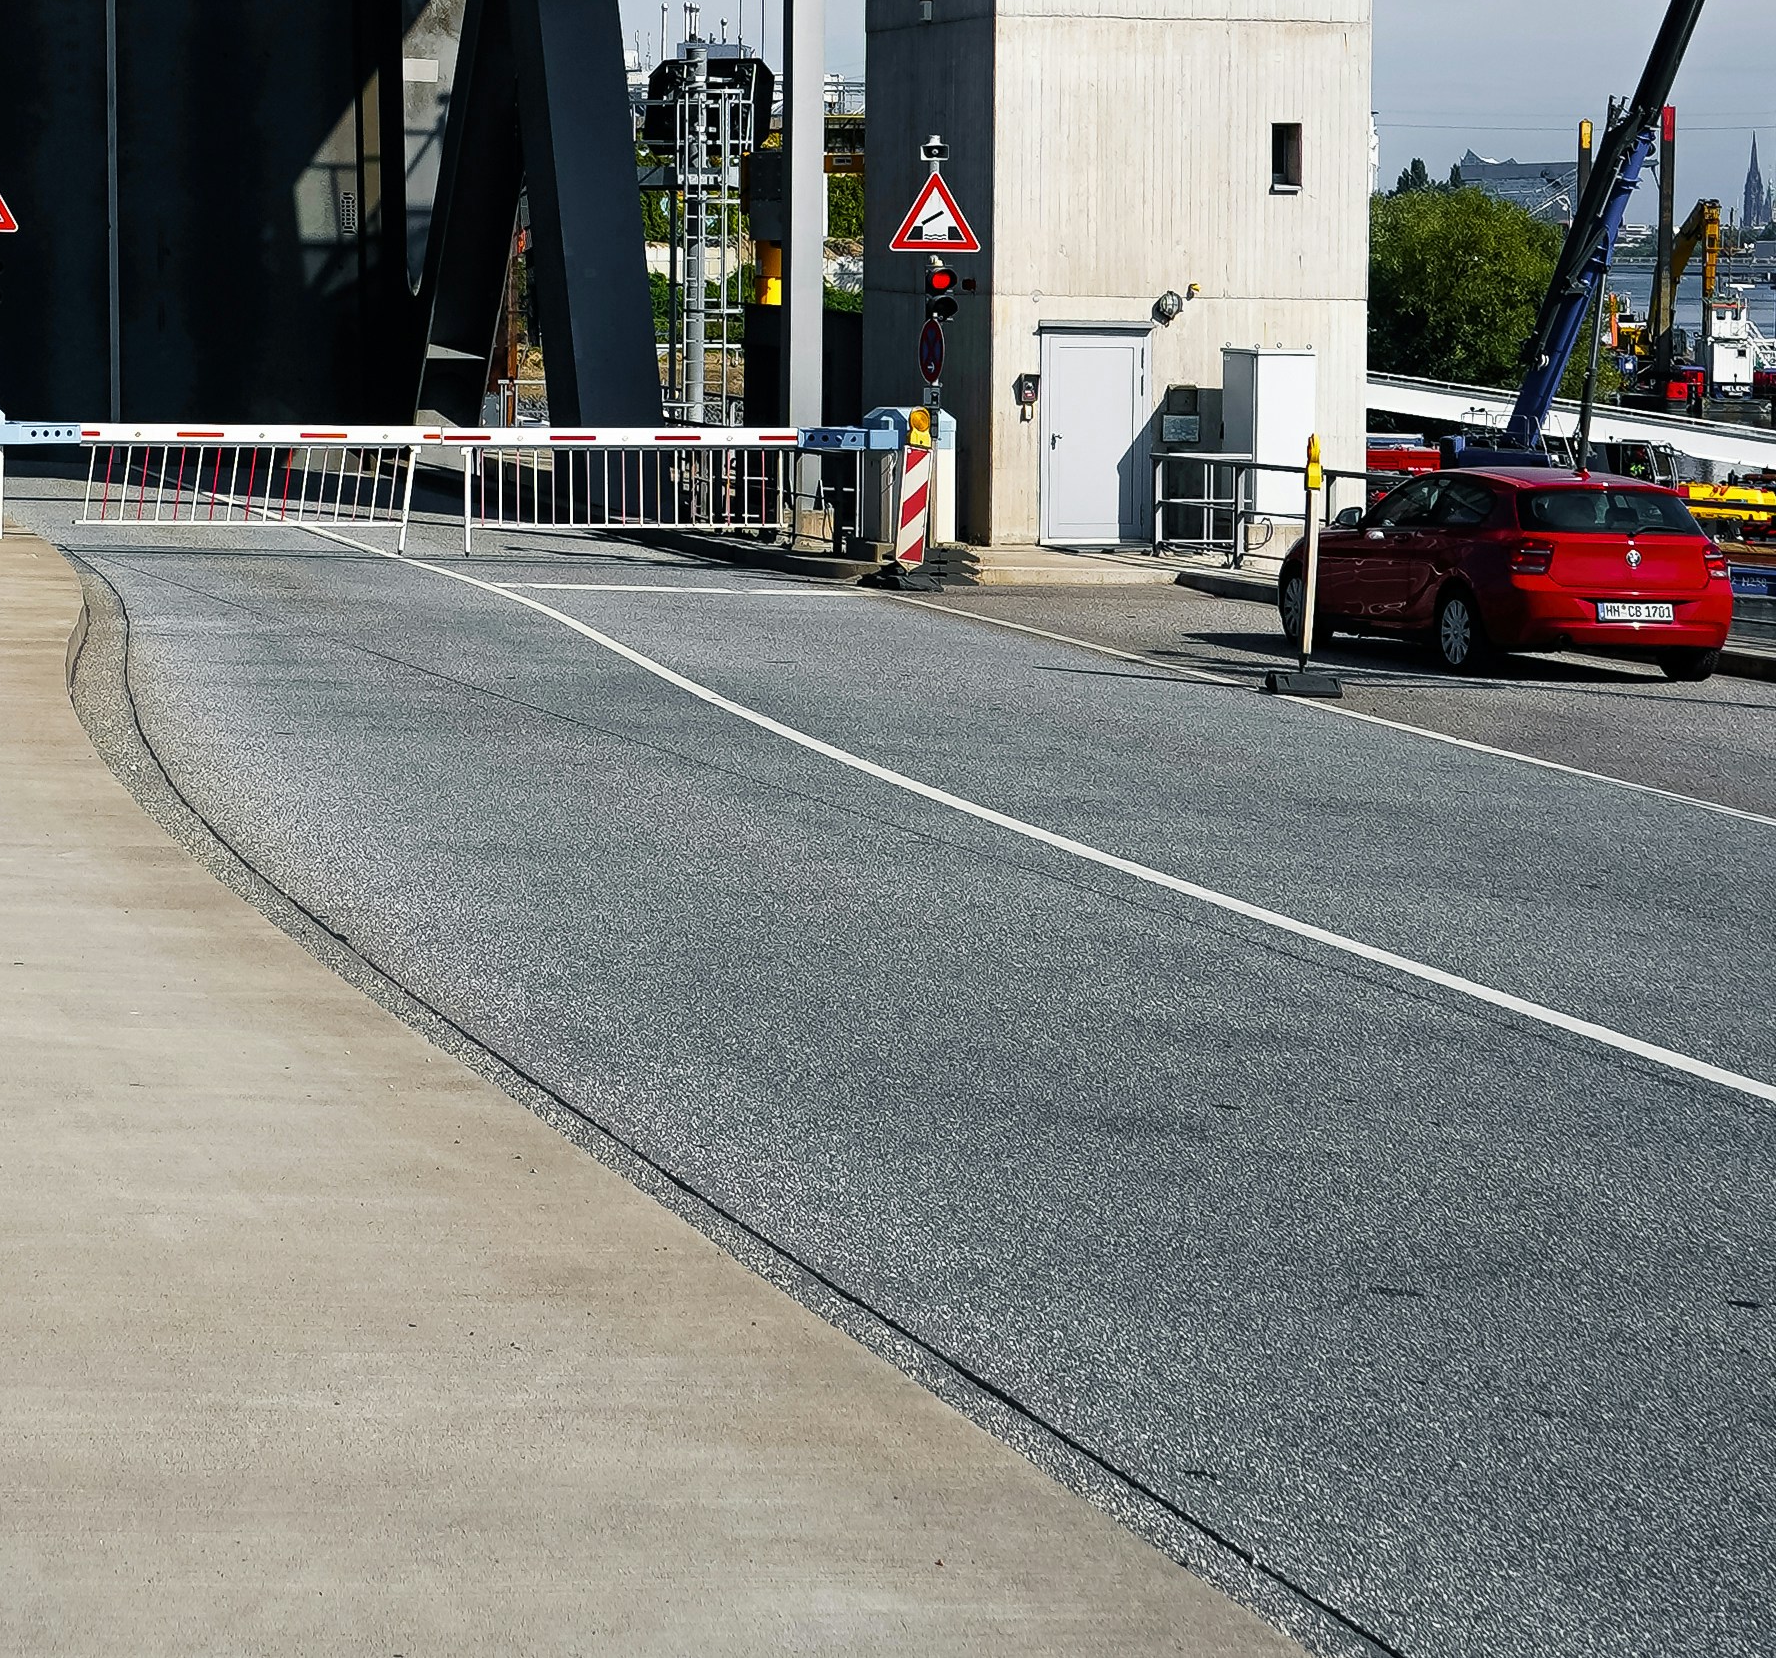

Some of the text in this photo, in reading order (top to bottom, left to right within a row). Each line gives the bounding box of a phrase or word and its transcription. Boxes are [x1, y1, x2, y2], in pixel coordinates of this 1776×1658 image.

[1606, 604, 1672, 618] HH CB 1701
